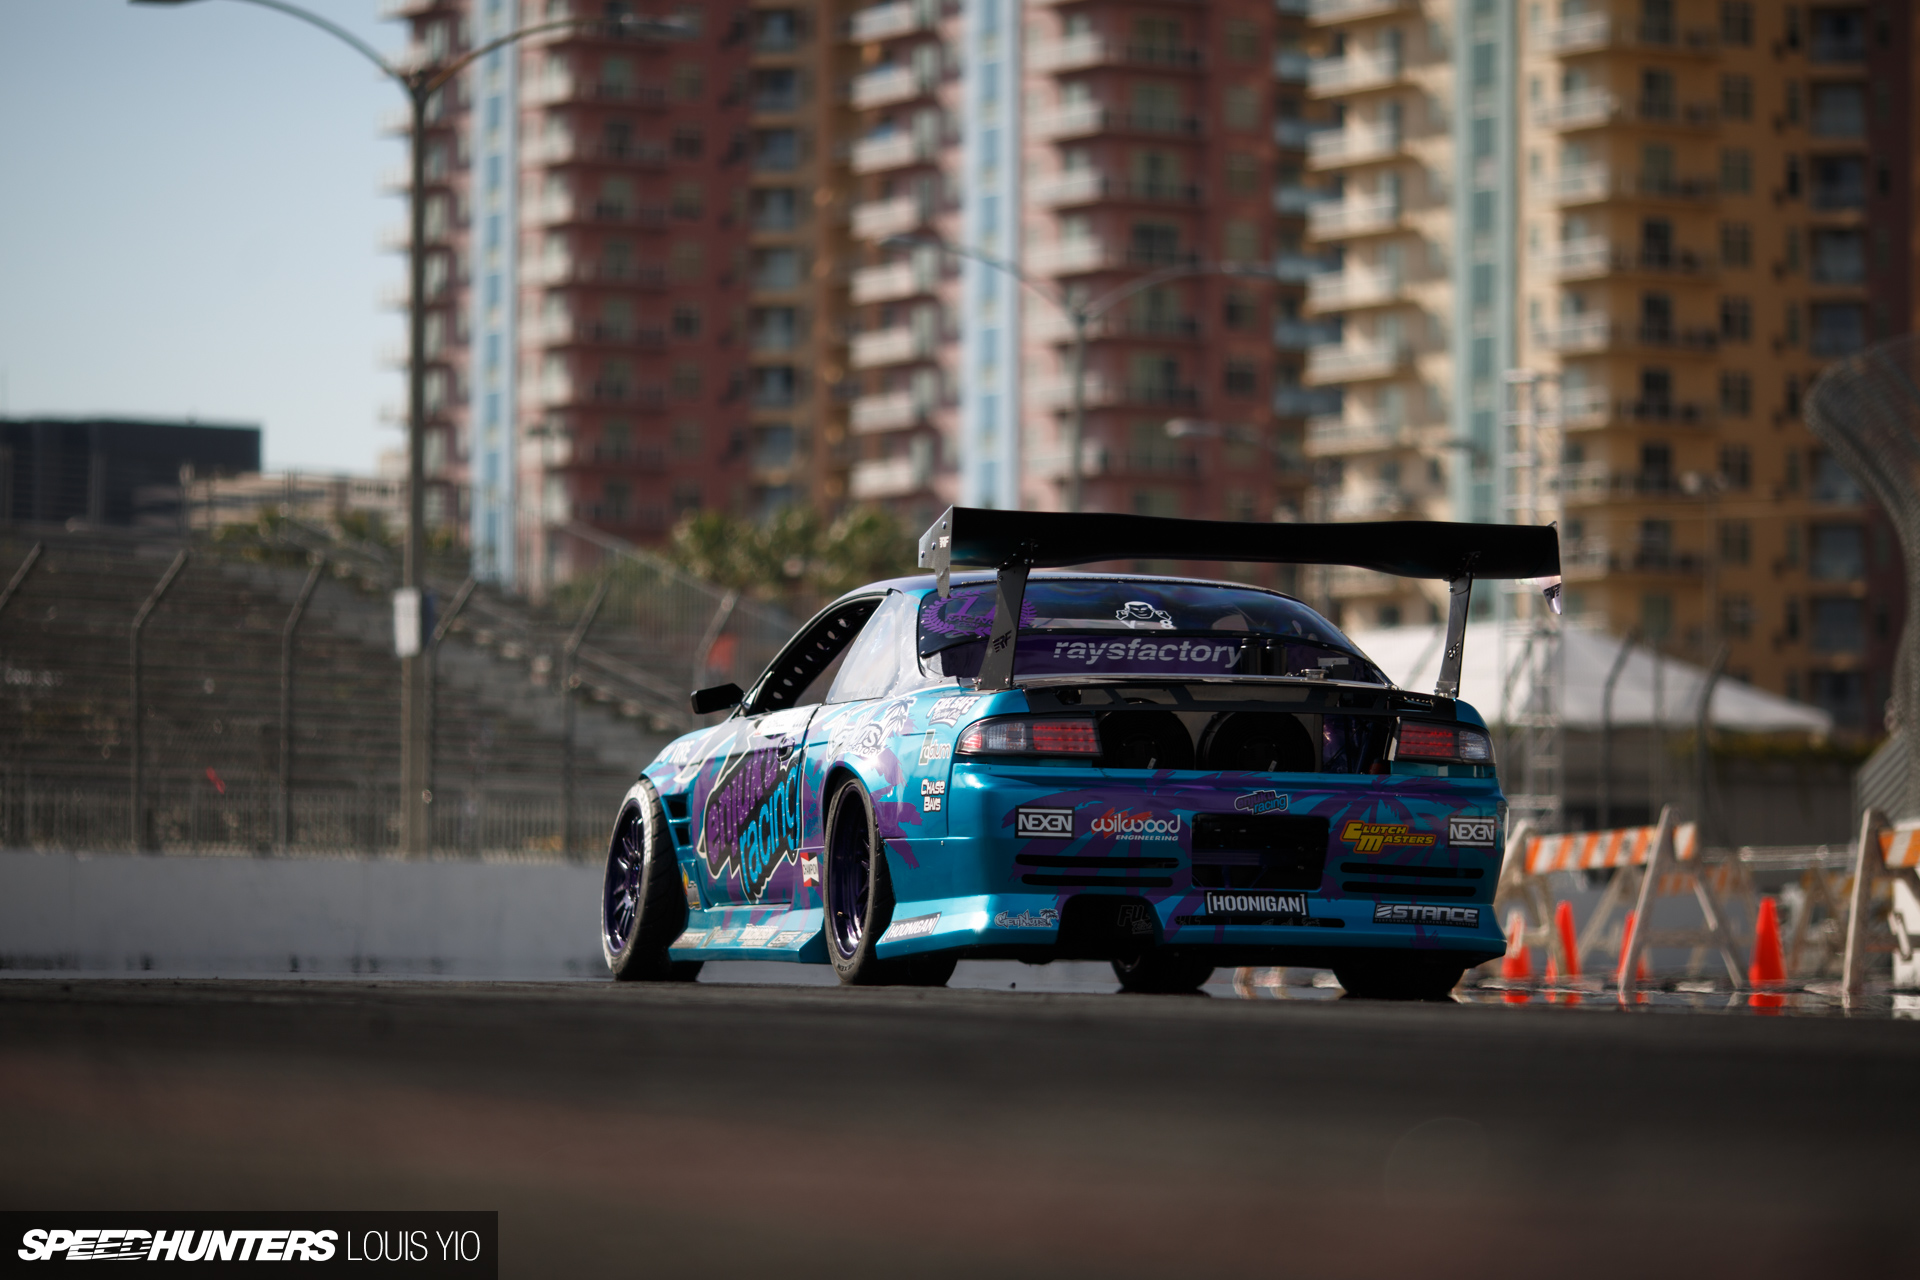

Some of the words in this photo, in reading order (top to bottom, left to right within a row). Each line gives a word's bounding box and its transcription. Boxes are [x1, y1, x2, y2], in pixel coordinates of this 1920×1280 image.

[1053, 638, 1240, 669] raysfactory
[1254, 796, 1287, 814] racing
[740, 763, 800, 893] racing
[1017, 813, 1073, 832] NEXEN
[1090, 813, 1181, 834] wilwood
[1449, 823, 1495, 841] NEXEN
[1115, 834, 1179, 842] ENGINEERING
[1391, 904, 1479, 923] STANCE
